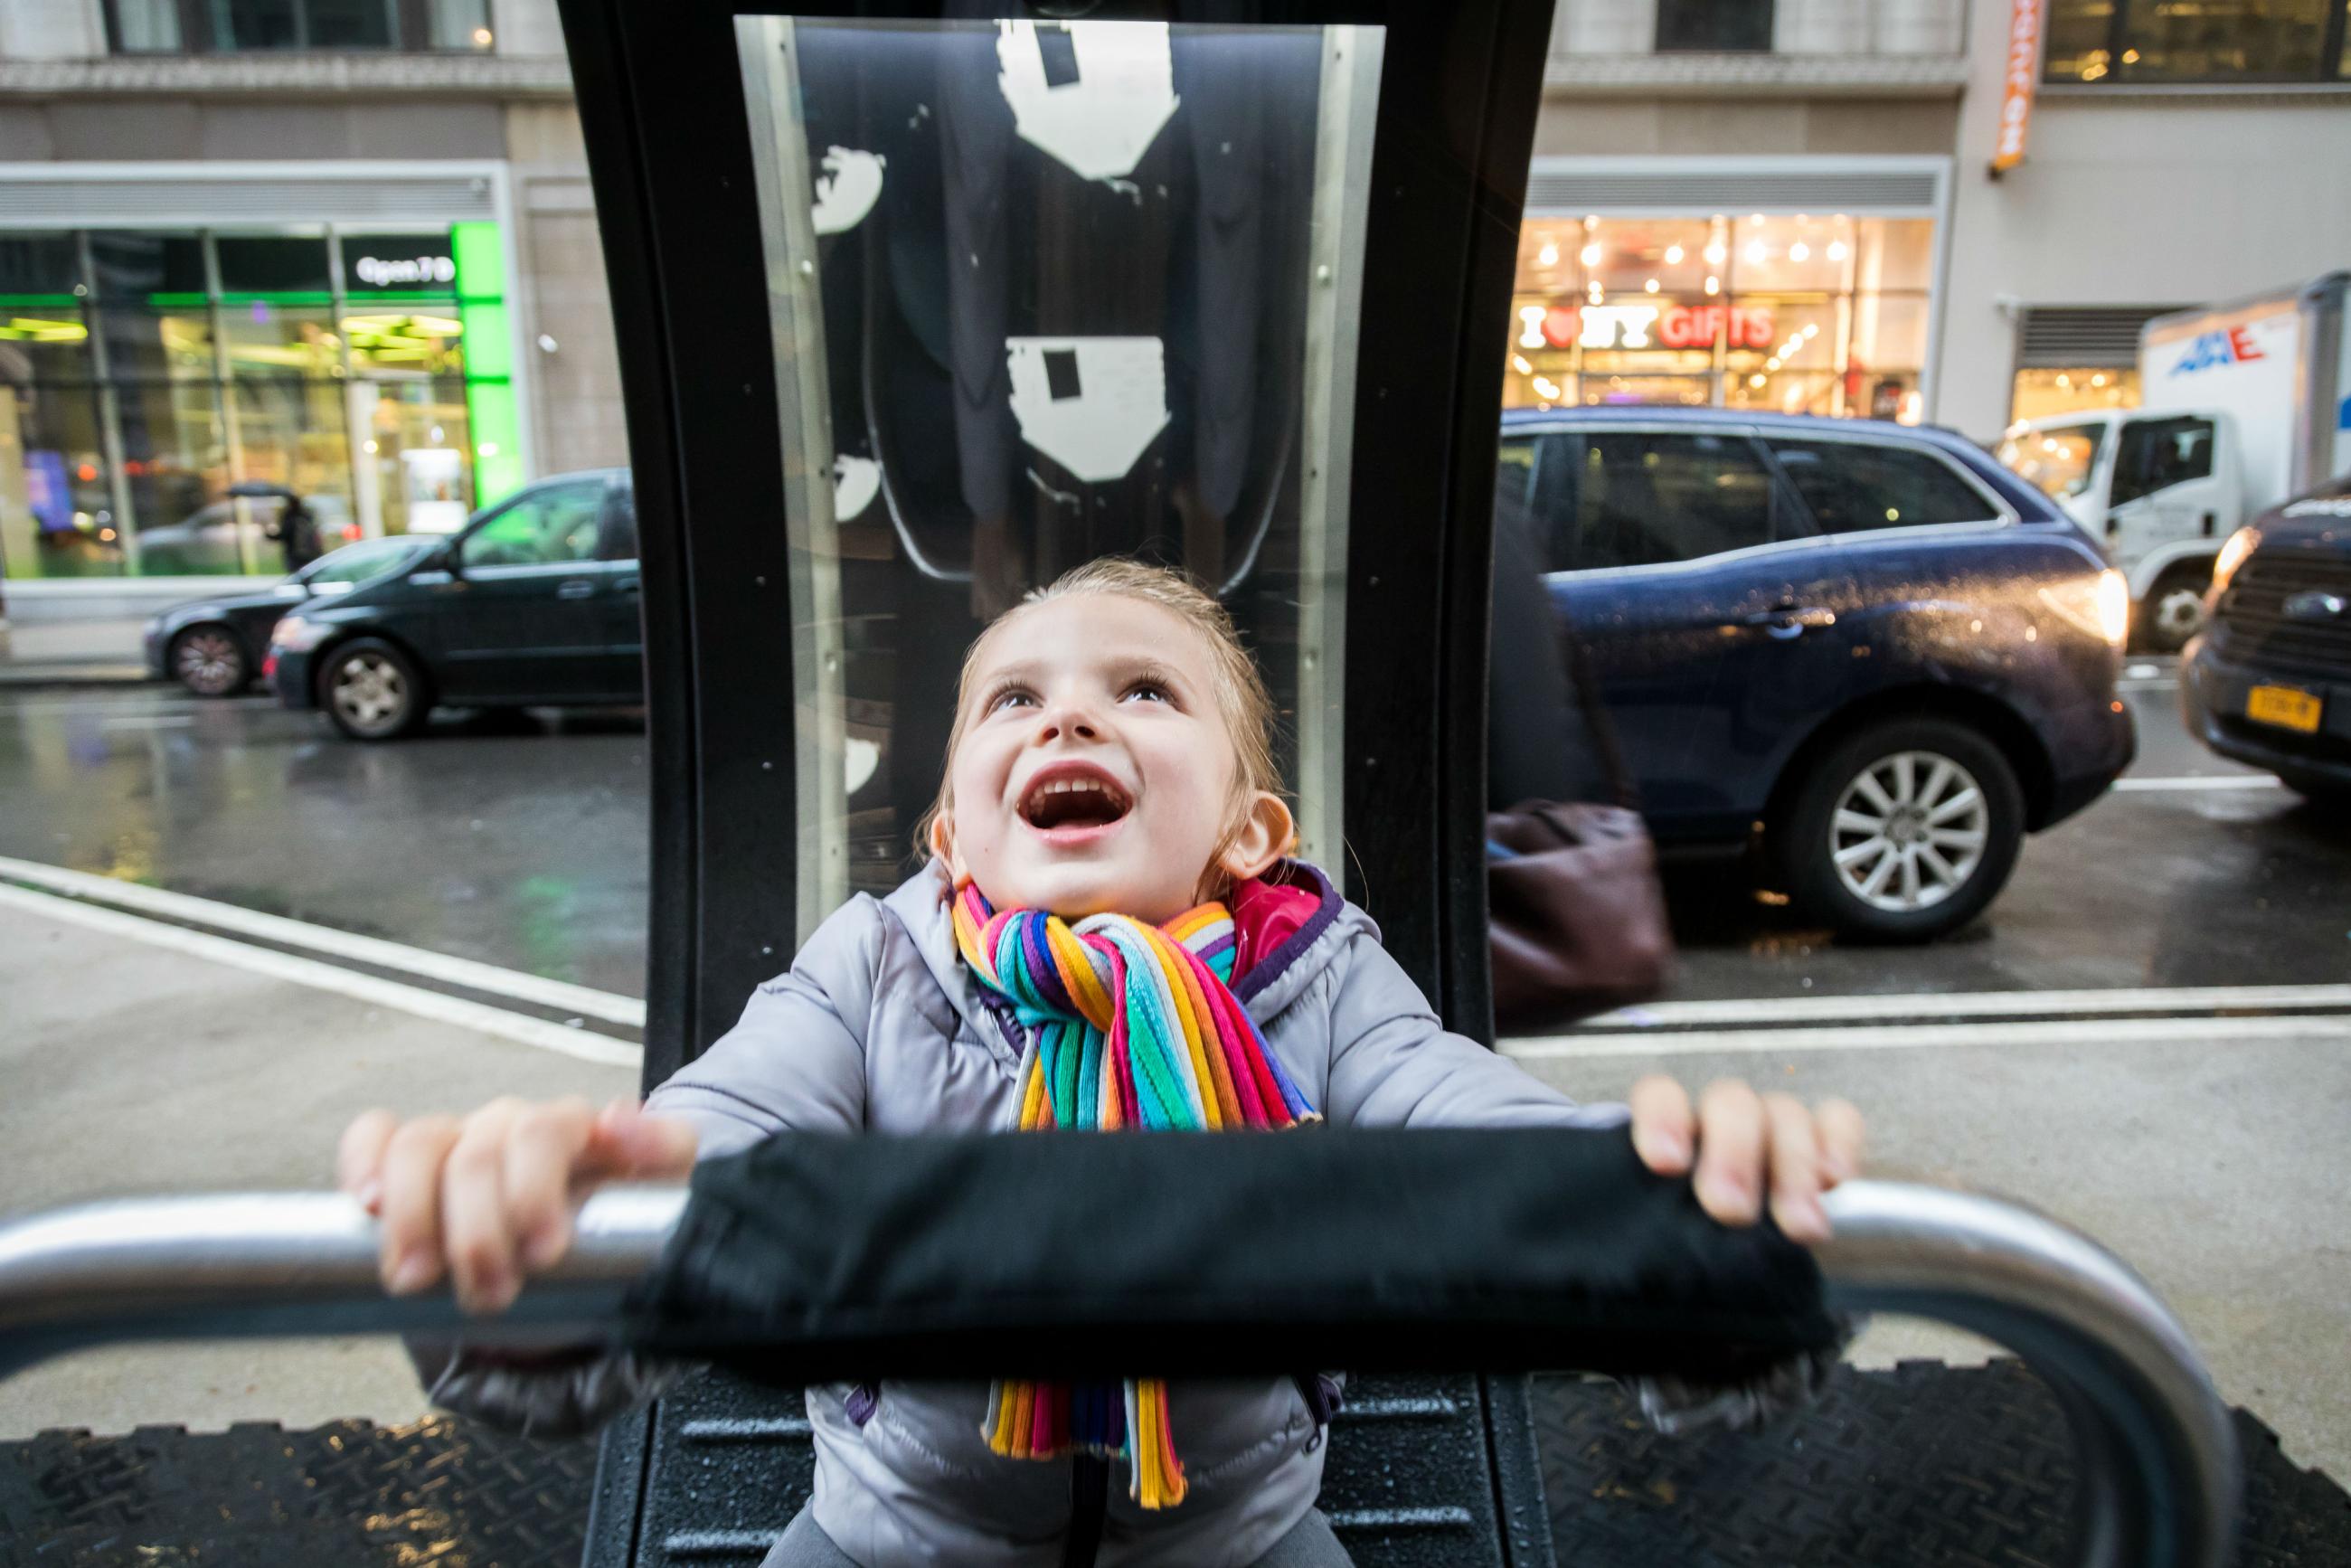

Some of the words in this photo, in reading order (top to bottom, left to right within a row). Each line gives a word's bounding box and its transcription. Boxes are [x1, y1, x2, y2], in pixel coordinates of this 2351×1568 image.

[355, 256, 419, 286] Open
[1518, 306, 1547, 348] I
[1578, 306, 1658, 348] NY
[1657, 305, 1774, 348] GIFTS
